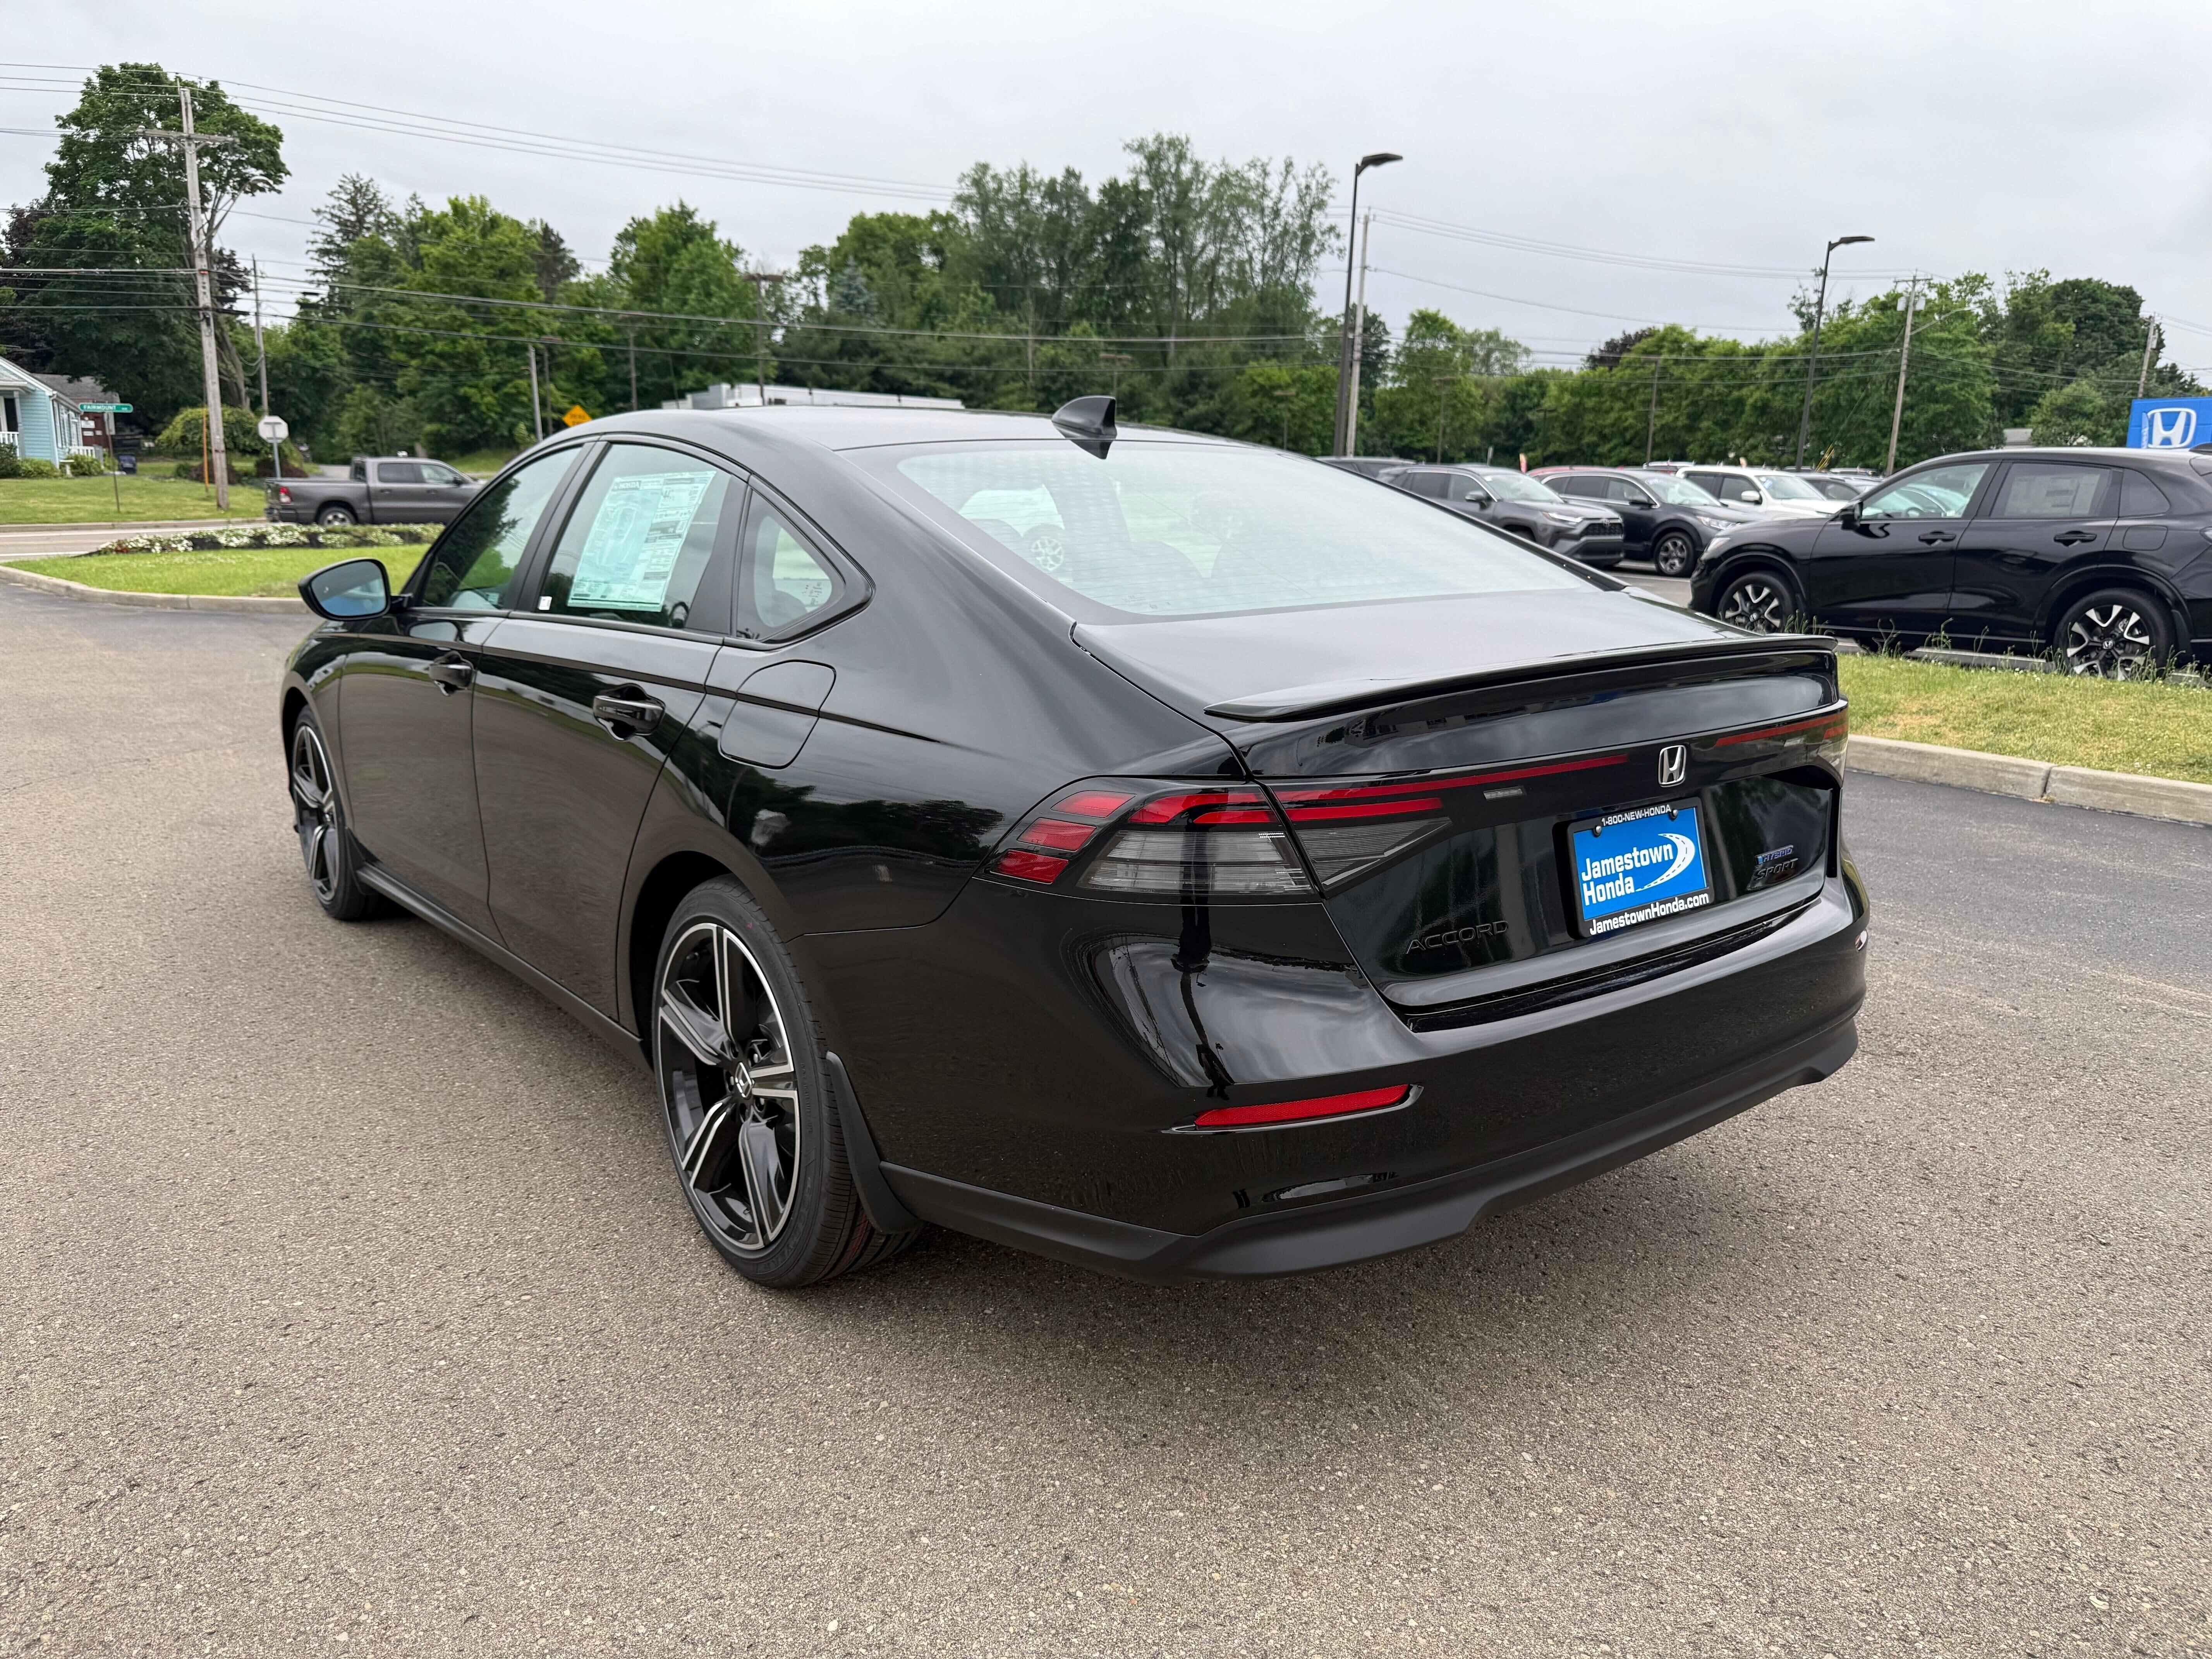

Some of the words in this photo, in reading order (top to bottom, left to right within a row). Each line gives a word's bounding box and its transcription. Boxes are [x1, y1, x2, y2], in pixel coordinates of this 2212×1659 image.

[1582, 843, 1673, 881] Jamestown
[1756, 858, 1798, 880] SPORT
[1763, 848, 1792, 862] HYBRID
[1583, 873, 1635, 906] Honda
[1590, 893, 1709, 935] JamestownHonda.com
[1406, 920, 1508, 954] ACCORD
